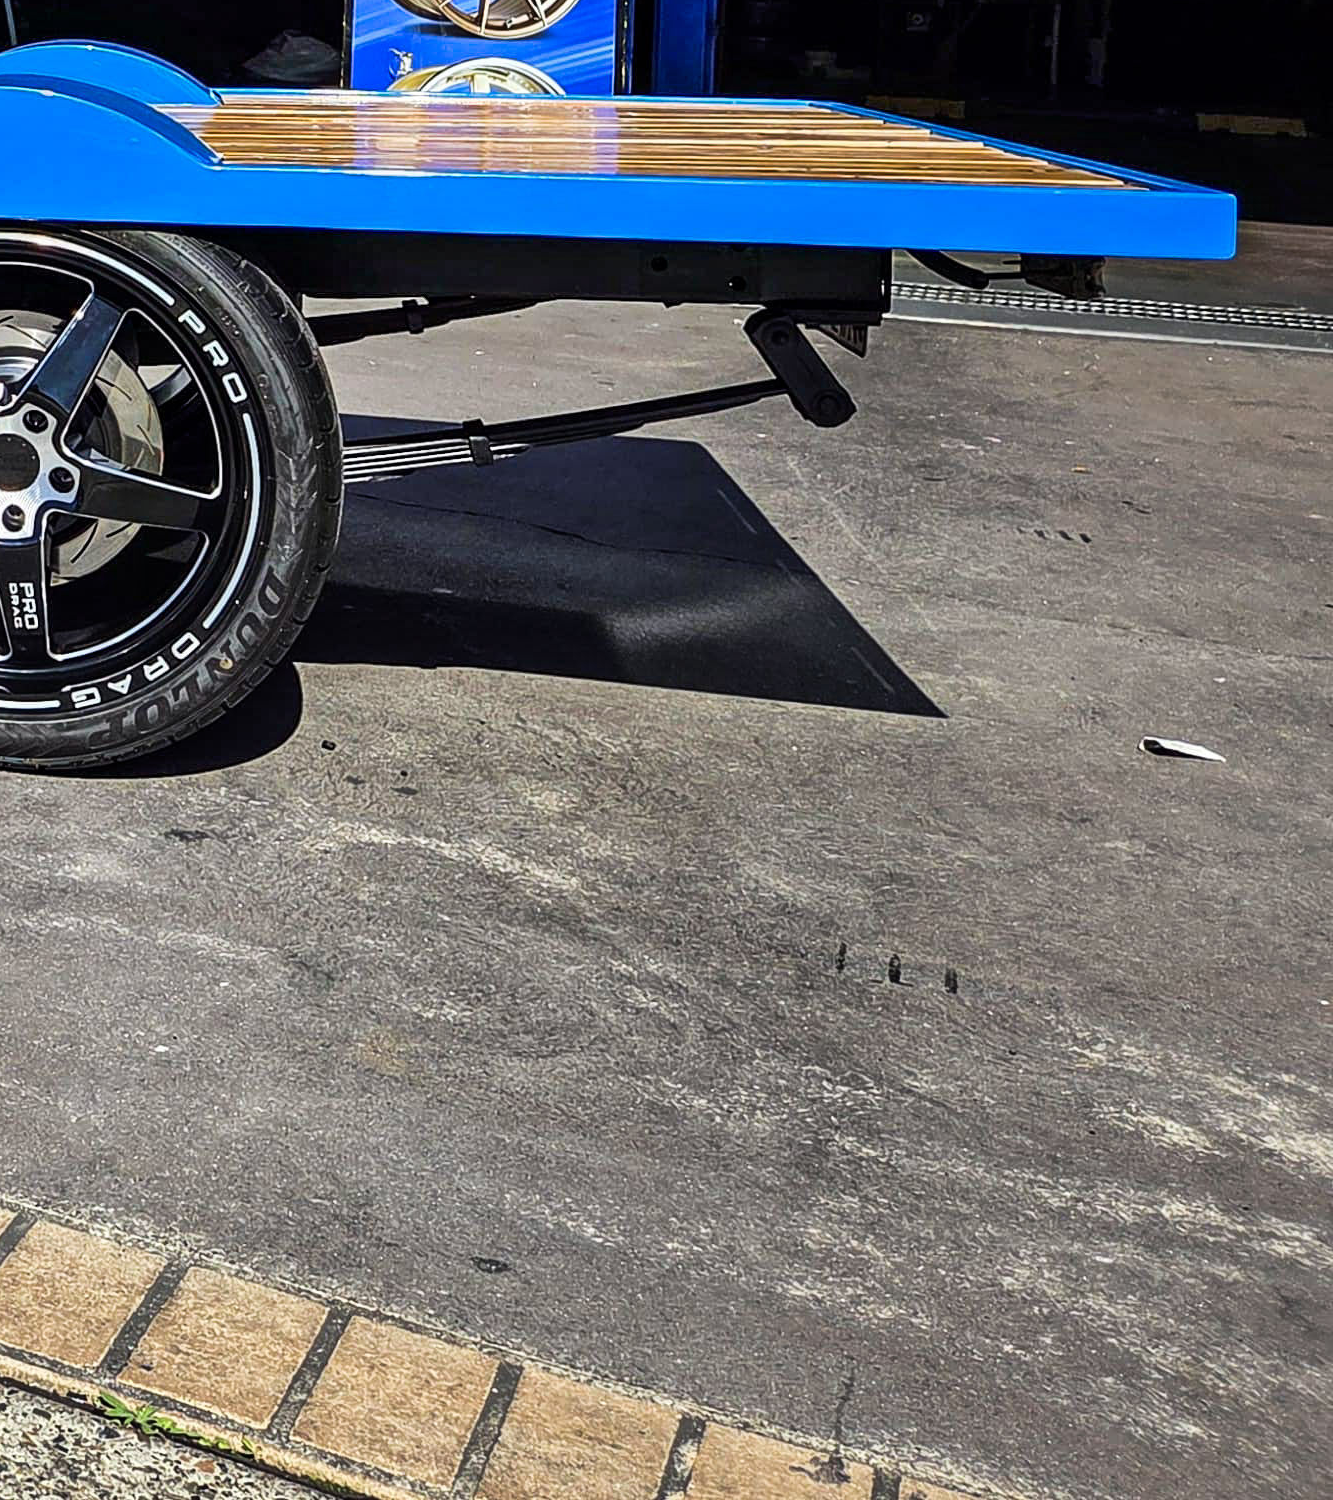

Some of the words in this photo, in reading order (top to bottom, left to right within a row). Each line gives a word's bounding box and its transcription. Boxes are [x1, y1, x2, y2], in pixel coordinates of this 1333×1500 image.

[178, 306, 248, 404] PRO
[8, 582, 23, 629] DRAG
[19, 582, 39, 630] PRO
[70, 637, 202, 710] DRAG
